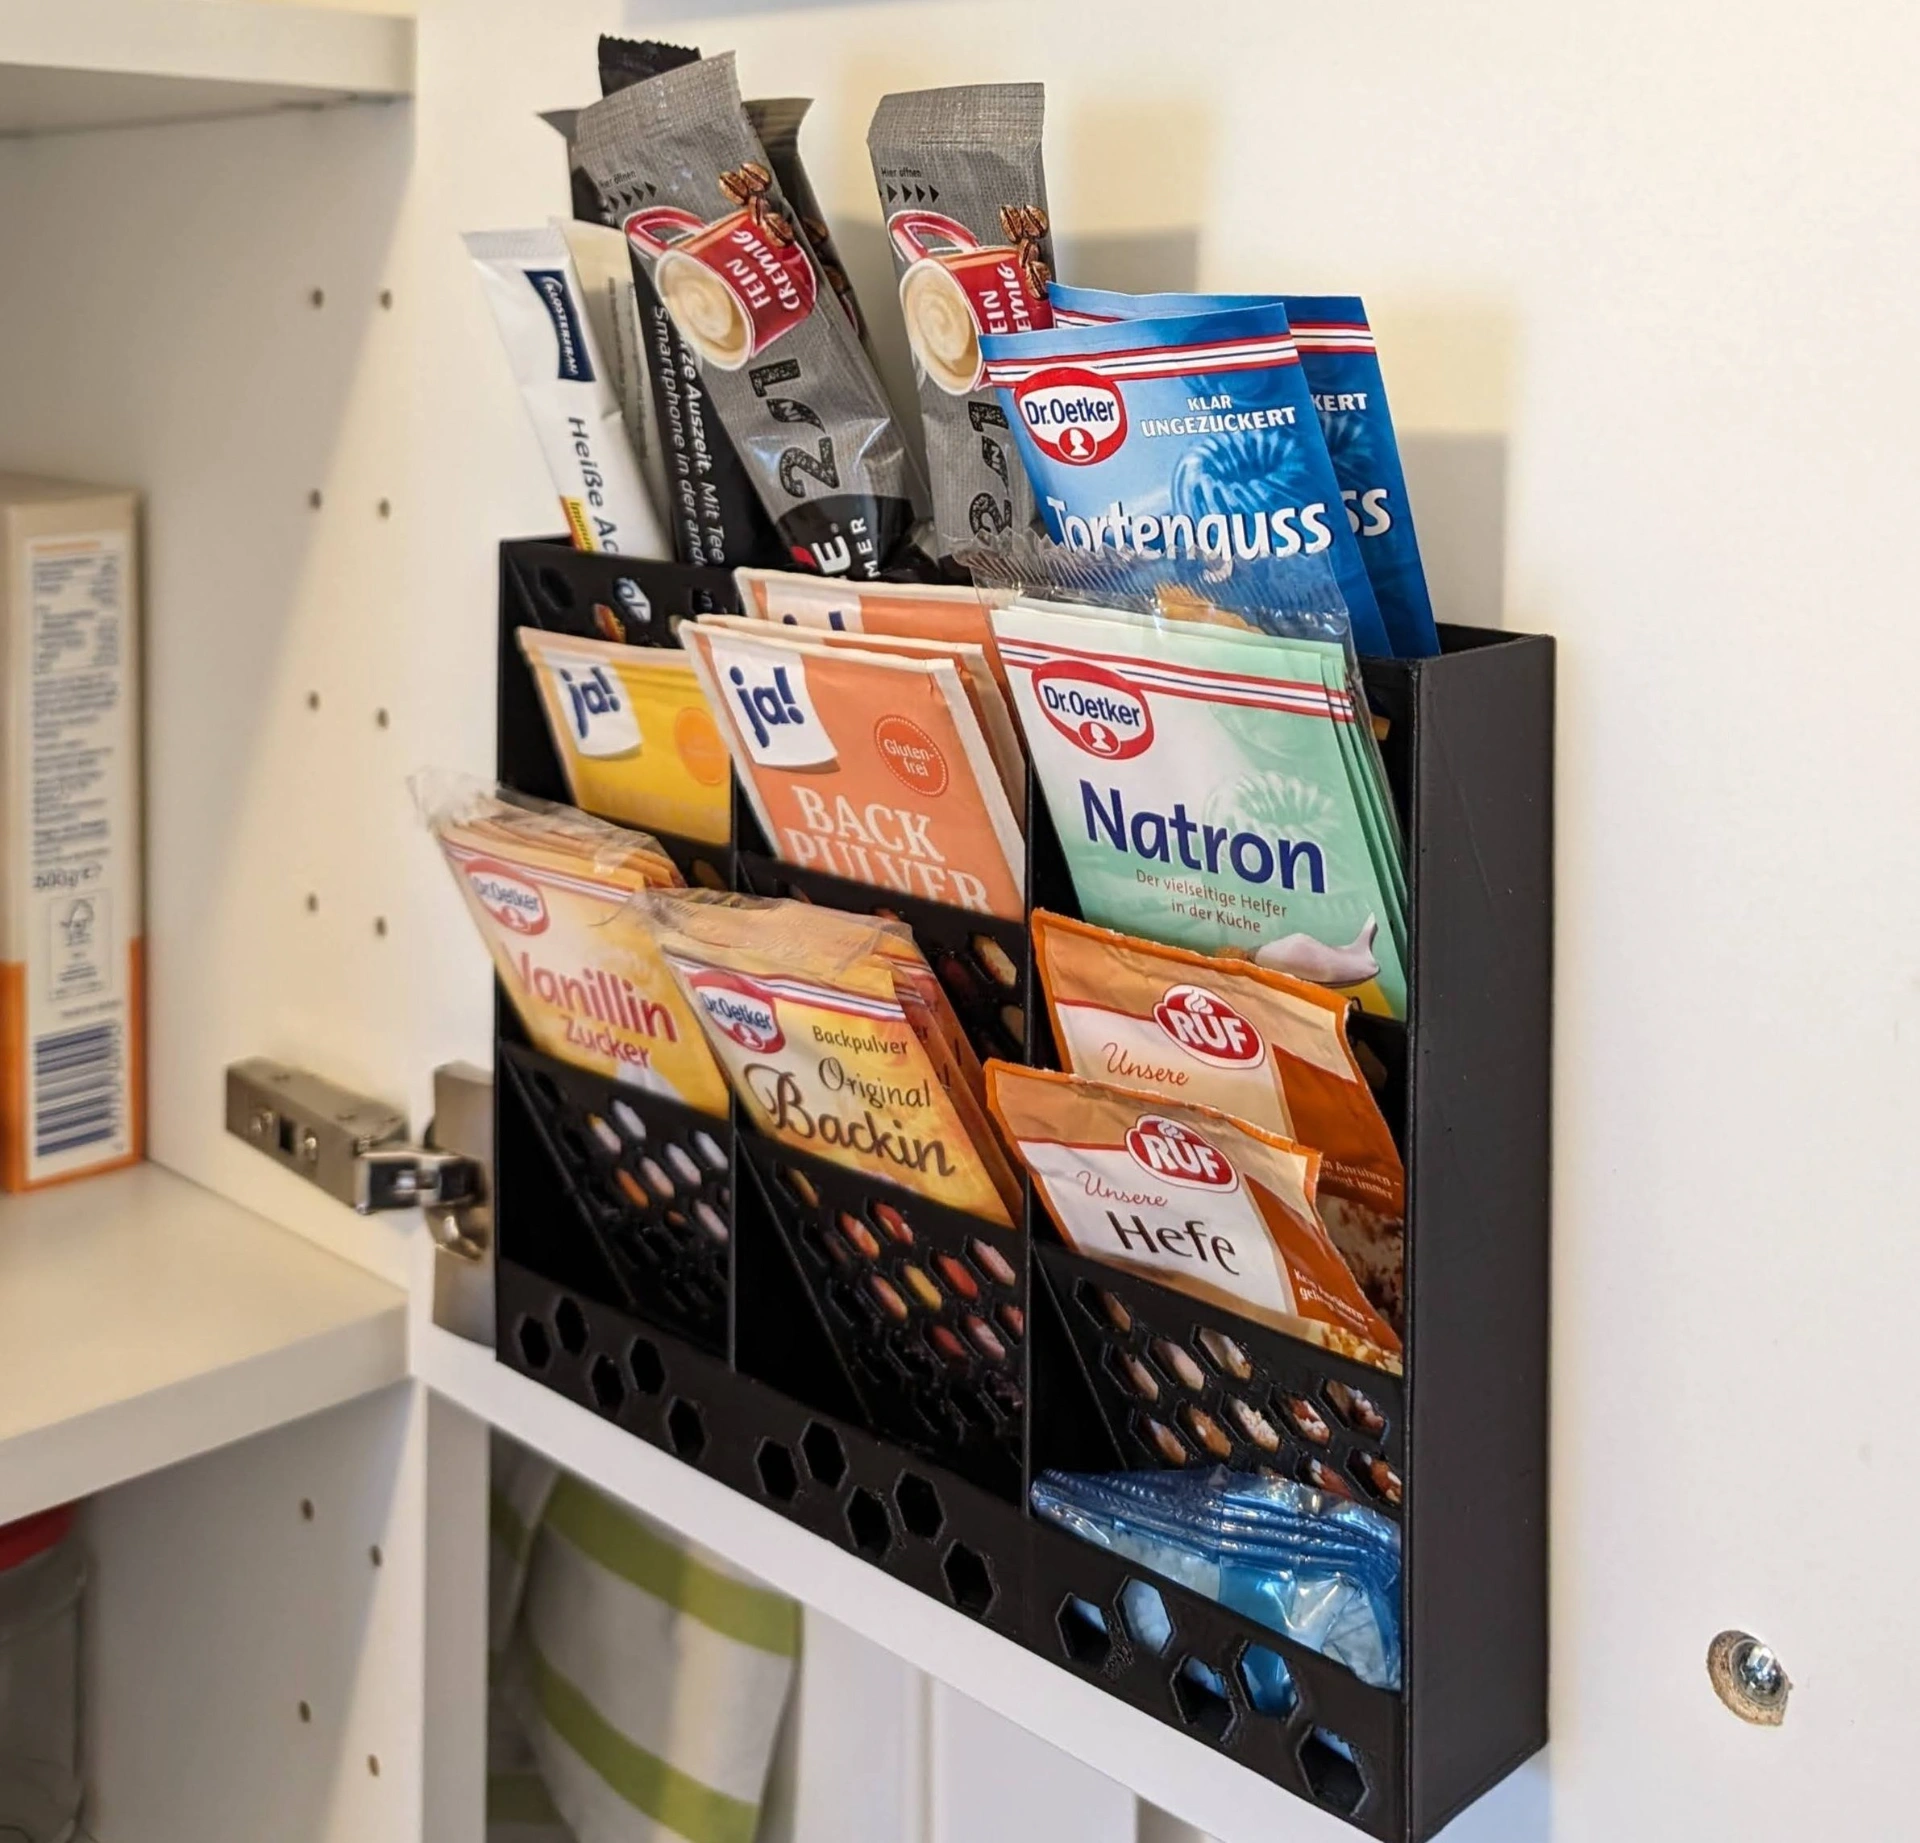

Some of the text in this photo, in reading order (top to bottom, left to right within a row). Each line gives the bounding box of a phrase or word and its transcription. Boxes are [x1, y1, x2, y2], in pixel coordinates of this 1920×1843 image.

[725, 258, 772, 310] FEIN
[731, 229, 800, 310] CREMIG
[653, 305, 686, 449] Smartphone
[686, 383, 712, 474] Auszeit.
[1139, 406, 1296, 438] UNGEZUCKERT
[1187, 394, 1232, 412] KLAR
[568, 417, 604, 508] Heiße
[676, 453, 691, 476] in
[680, 479, 696, 519] der
[700, 482, 720, 519] Mit
[707, 526, 725, 564] Tee
[1046, 495, 1335, 584] Tortenguss
[560, 667, 621, 739] ja!
[729, 666, 805, 748] ja!
[884, 738, 934, 761] Gluten-
[903, 757, 929, 776] frei
[791, 784, 945, 862] BACK
[1079, 778, 1326, 895] Natron
[1136, 868, 1287, 918] Der vielseitige Helfer
[1171, 899, 1261, 933] in der Küche
[503, 944, 678, 1043] Vanillin
[559, 1013, 651, 1068] Zucker
[812, 1025, 908, 1056] Backpulver
[1166, 1008, 1247, 1054] RUF
[818, 1057, 931, 1109] Original
[1101, 1042, 1189, 1086] Unsere
[744, 1063, 956, 1177] Backin
[1139, 1133, 1220, 1179] RUF
[1076, 1170, 1168, 1207] Unsere
[1106, 1210, 1240, 1276] Hefe
